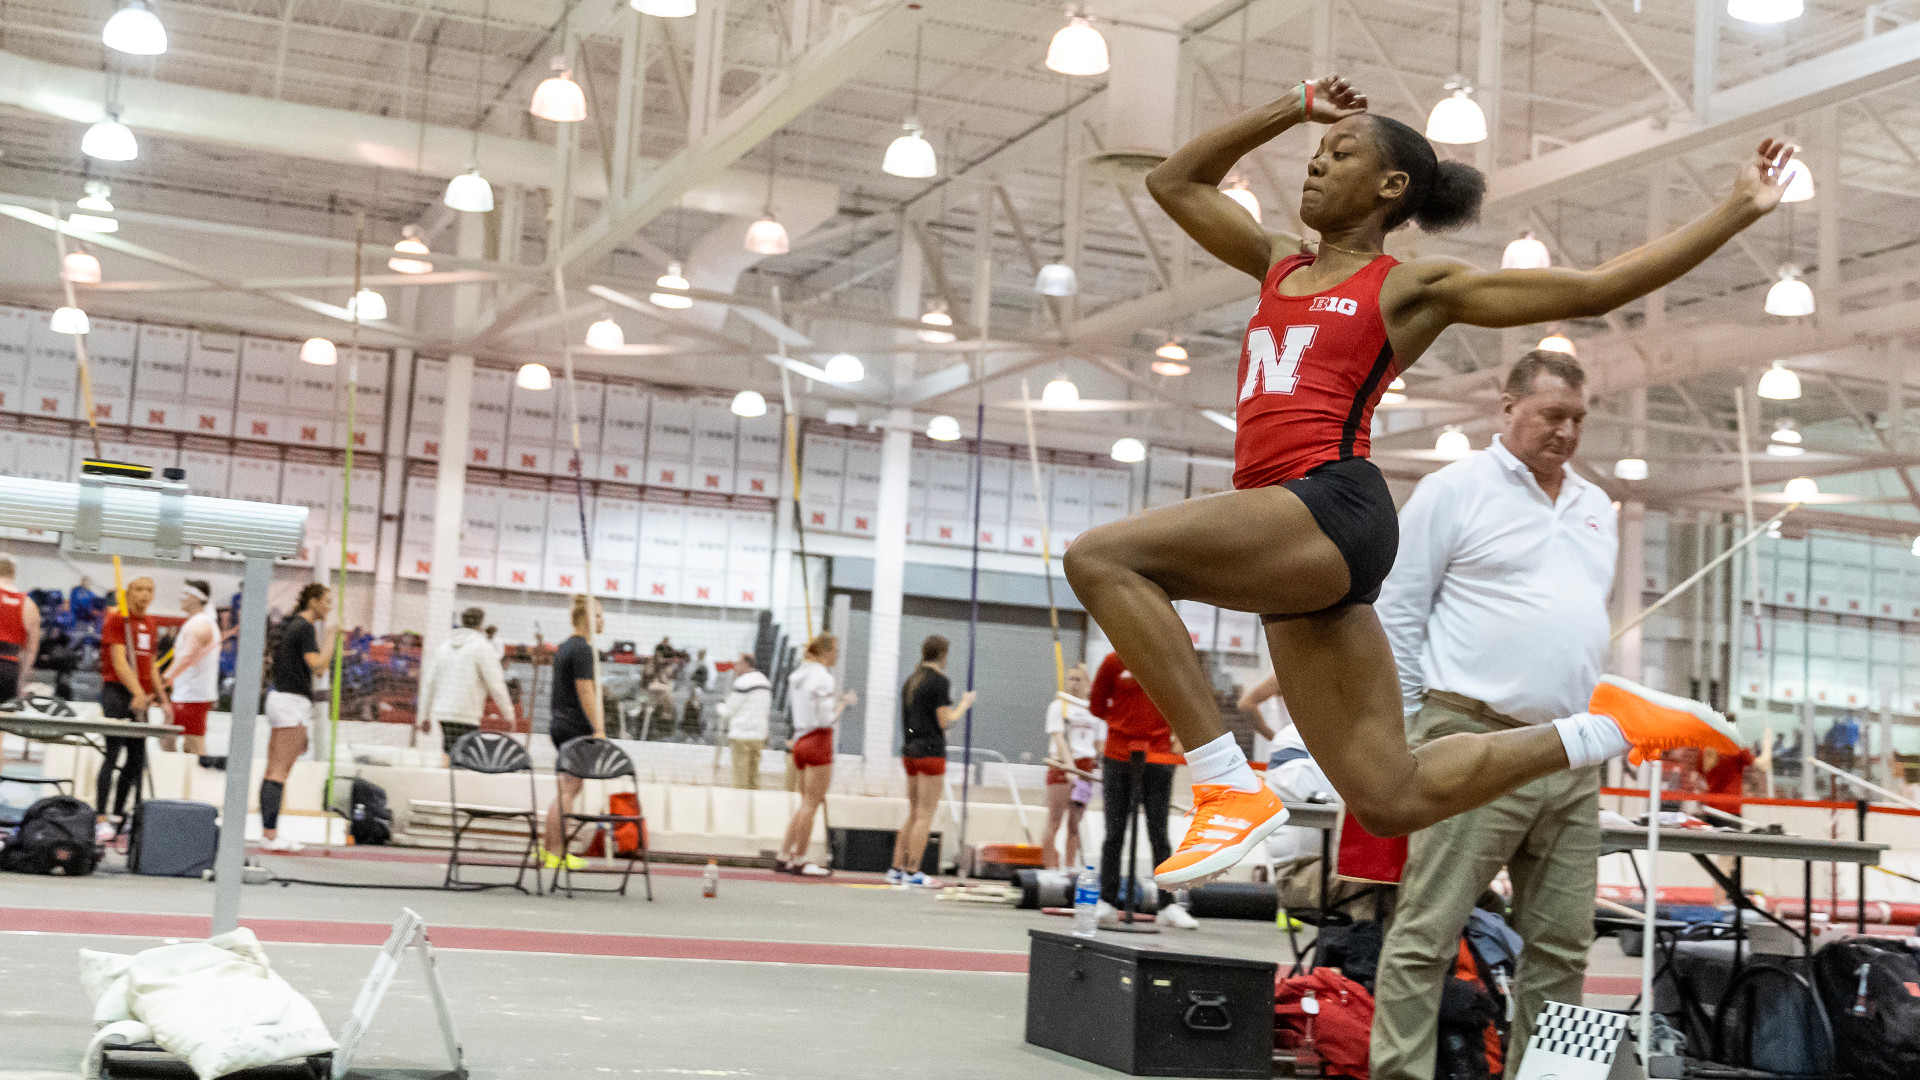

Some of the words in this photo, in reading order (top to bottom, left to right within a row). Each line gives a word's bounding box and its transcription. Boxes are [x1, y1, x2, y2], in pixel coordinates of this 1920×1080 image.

[1238, 325, 1320, 405] N
[42, 398, 57, 412] N
[95, 404, 111, 418] N
[149, 410, 164, 424] N
[199, 415, 215, 429] N
[252, 422, 267, 435] N
[302, 427, 316, 441] N
[351, 432, 366, 446] N
[424, 442, 438, 455] N
[474, 449, 487, 461] N
[522, 454, 536, 467] N
[614, 465, 627, 477] N
[661, 471, 674, 482] N
[706, 475, 718, 487] N
[752, 480, 763, 491] N
[346, 551, 358, 564] N
[417, 561, 430, 573] N
[465, 566, 478, 578] N
[512, 571, 525, 583] N
[560, 575, 572, 587] N
[606, 579, 618, 591] N
[653, 584, 664, 595] N
[697, 588, 709, 599] N
[742, 591, 753, 601] N
